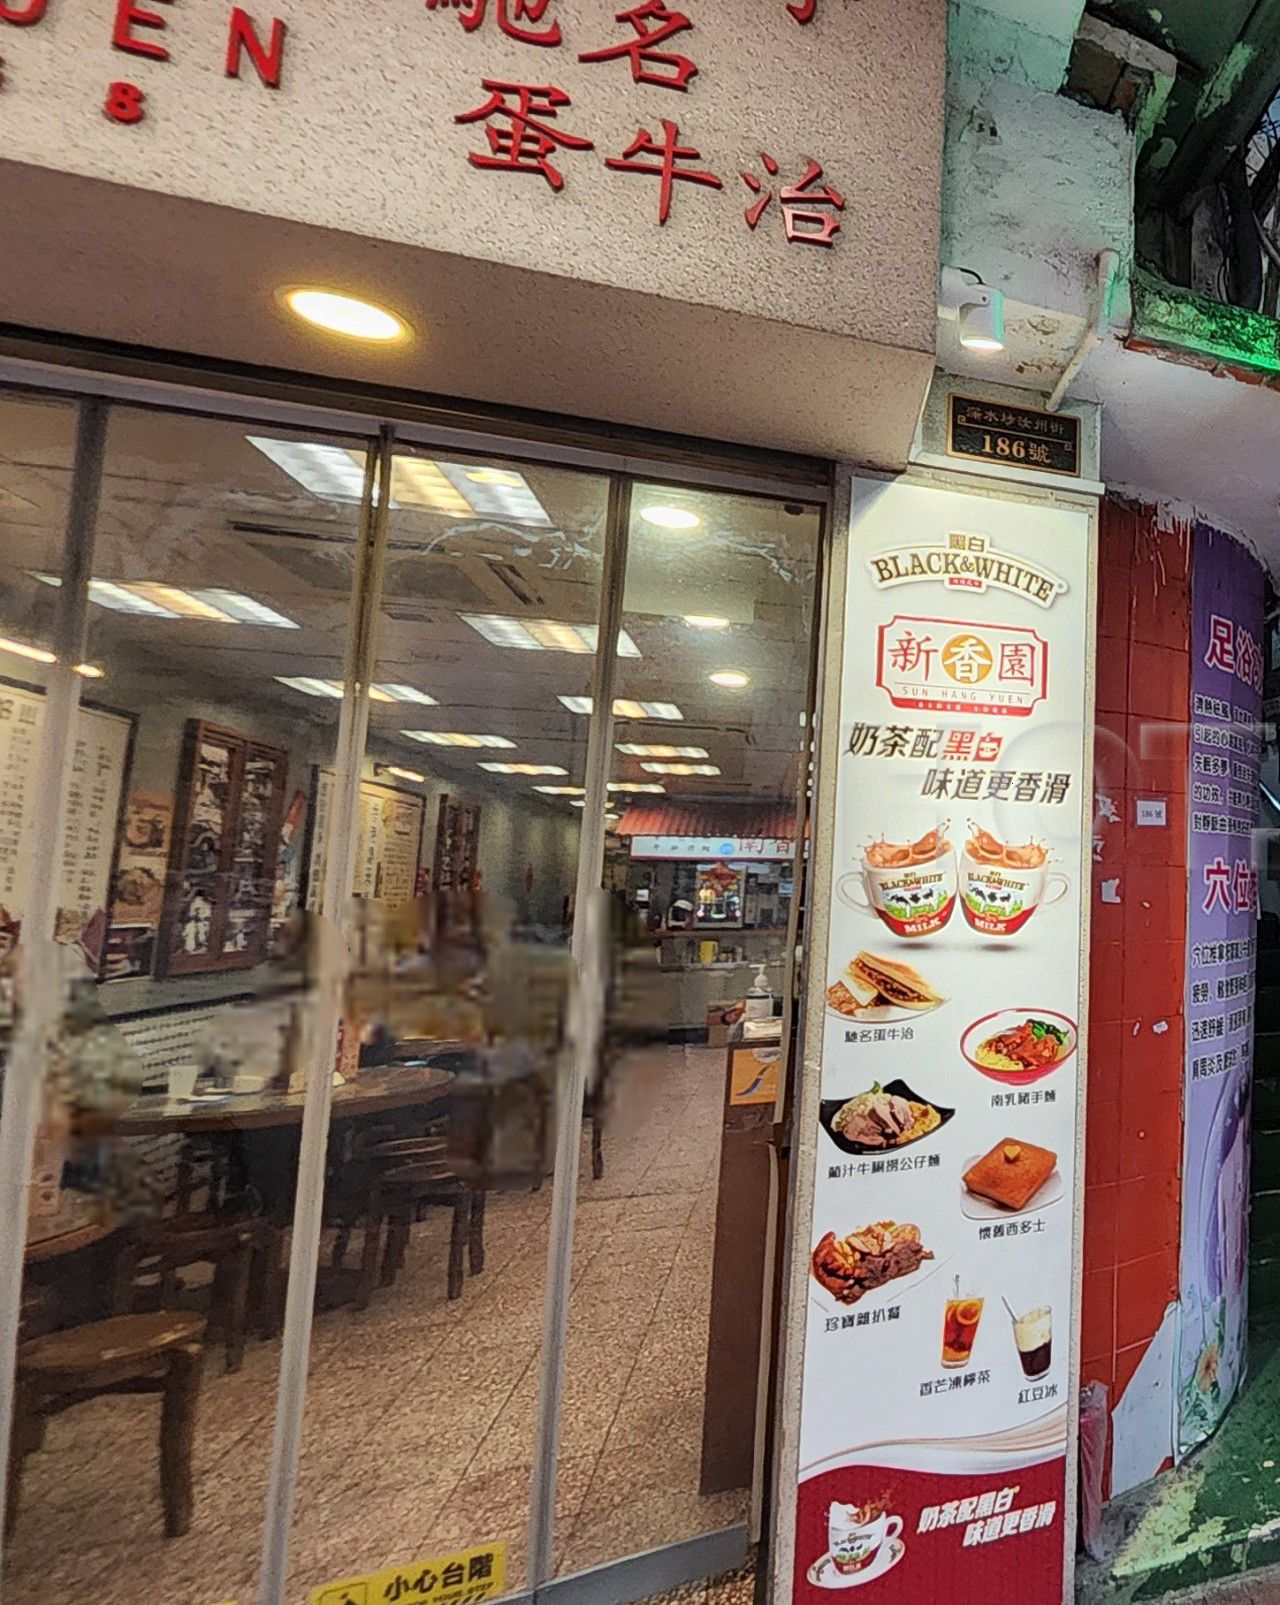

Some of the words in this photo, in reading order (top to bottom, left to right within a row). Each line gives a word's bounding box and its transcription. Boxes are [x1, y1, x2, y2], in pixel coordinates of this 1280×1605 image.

[453, 77, 847, 249] 蛋牛治
[981, 433, 1052, 465] 186號
[869, 550, 1056, 603] BLACK&WHITE
[887, 630, 1037, 688] 新香園
[902, 686, 929, 697] SUN
[941, 690, 977, 701] HANG
[989, 693, 1024, 704] YUEN
[843, 720, 1005, 763] 奶茶配黑白
[919, 766, 1073, 805] 味道更香滑
[903, 917, 942, 934] MILK
[973, 917, 1007, 932] MILK
[844, 1026, 915, 1044] 馳名蛋牛治
[1017, 1383, 1059, 1405] 紅豆冰
[915, 1485, 1021, 1536] 奶茶配黑白
[961, 1500, 1058, 1549] 味道更香滑
[382, 1552, 496, 1601] 小心台階
